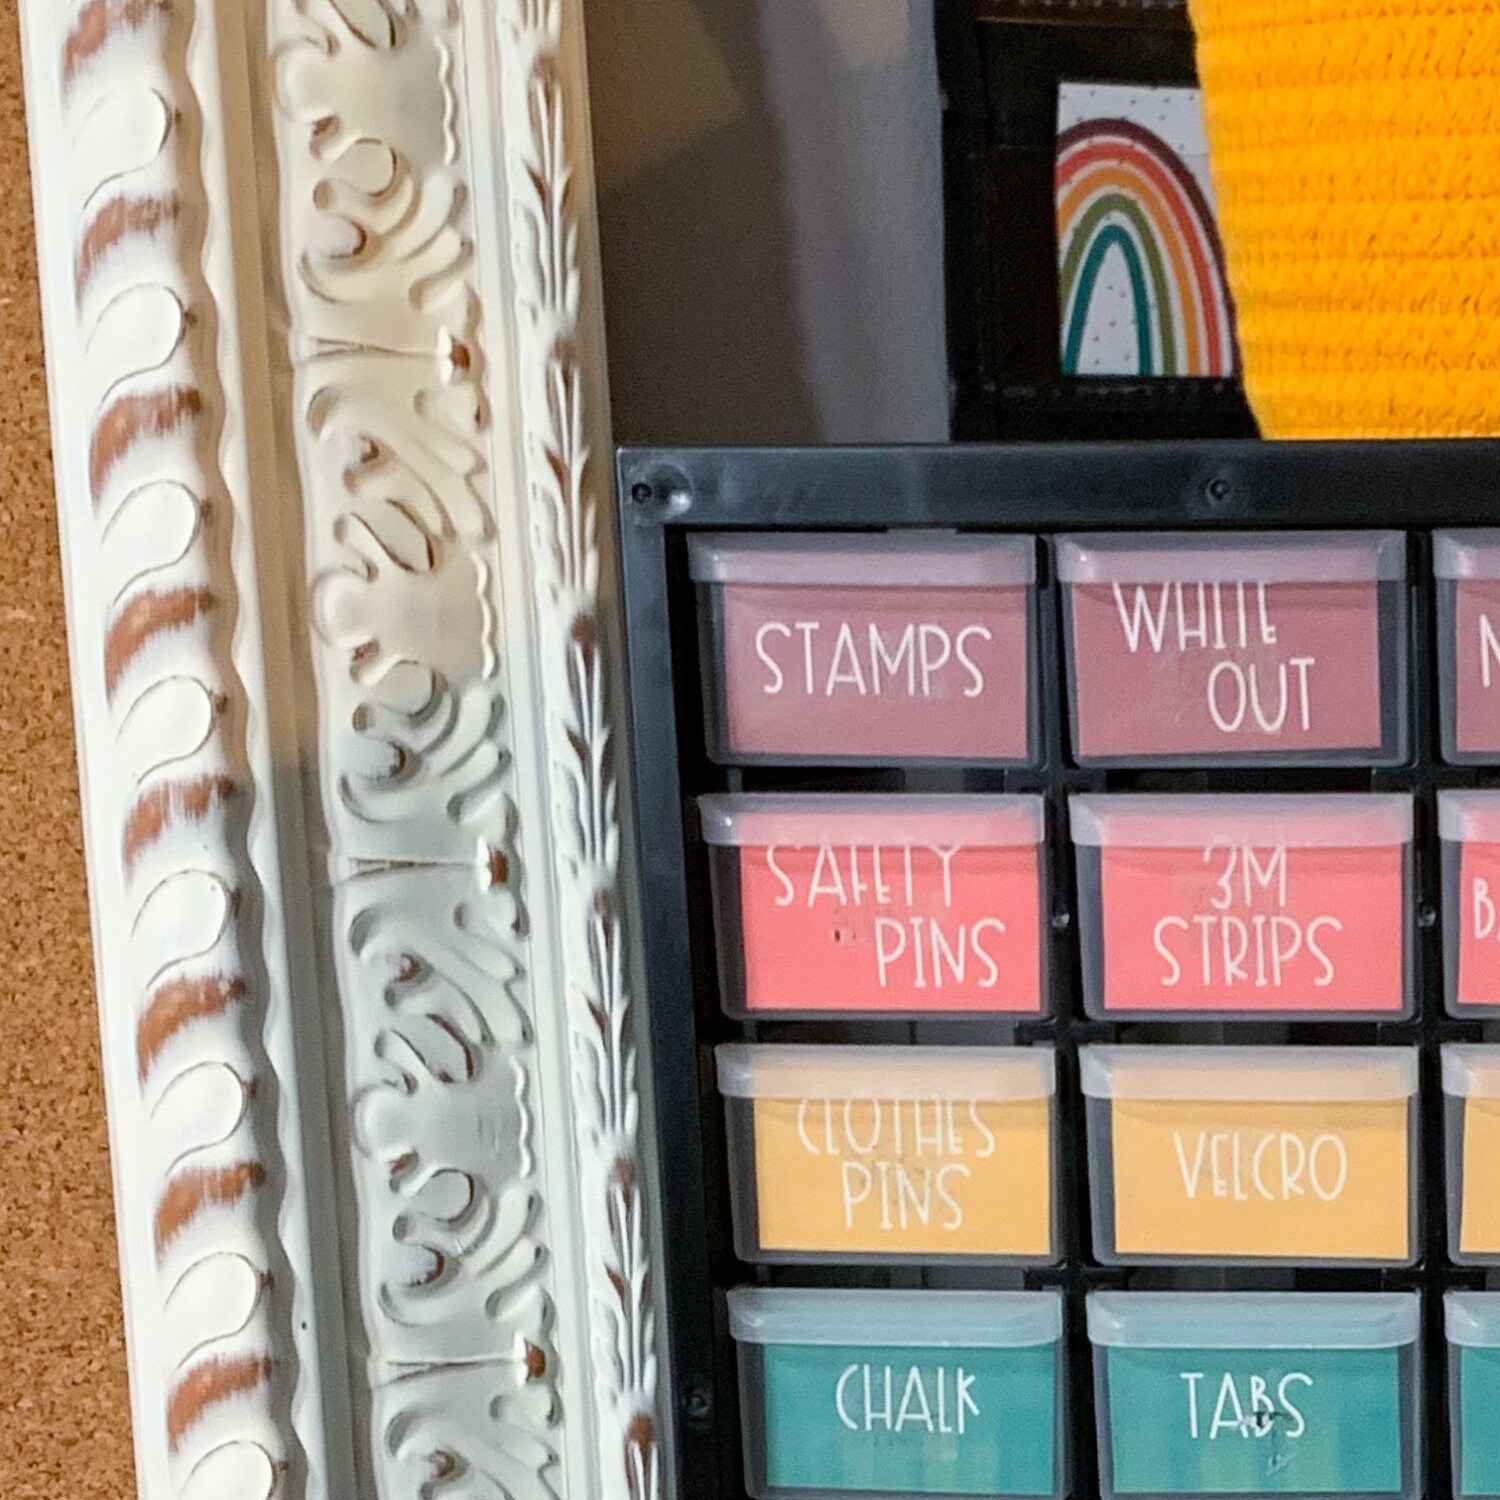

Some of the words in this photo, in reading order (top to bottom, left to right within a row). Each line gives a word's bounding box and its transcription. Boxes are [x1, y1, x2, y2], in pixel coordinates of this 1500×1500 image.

[1112, 581, 1278, 653] WHITE
[755, 621, 991, 696] STAMPS
[1208, 658, 1315, 732] OUT
[766, 842, 963, 908] SAFETY
[1203, 838, 1287, 909] 3M
[875, 917, 1006, 987] PINS
[1153, 915, 1343, 987] STRIPS
[798, 1093, 995, 1158] CLOTHES
[842, 1162, 971, 1230] PINS
[1174, 1133, 1346, 1200] VELCRO
[836, 1365, 980, 1434] CHALK
[1181, 1373, 1313, 1440] TABS
